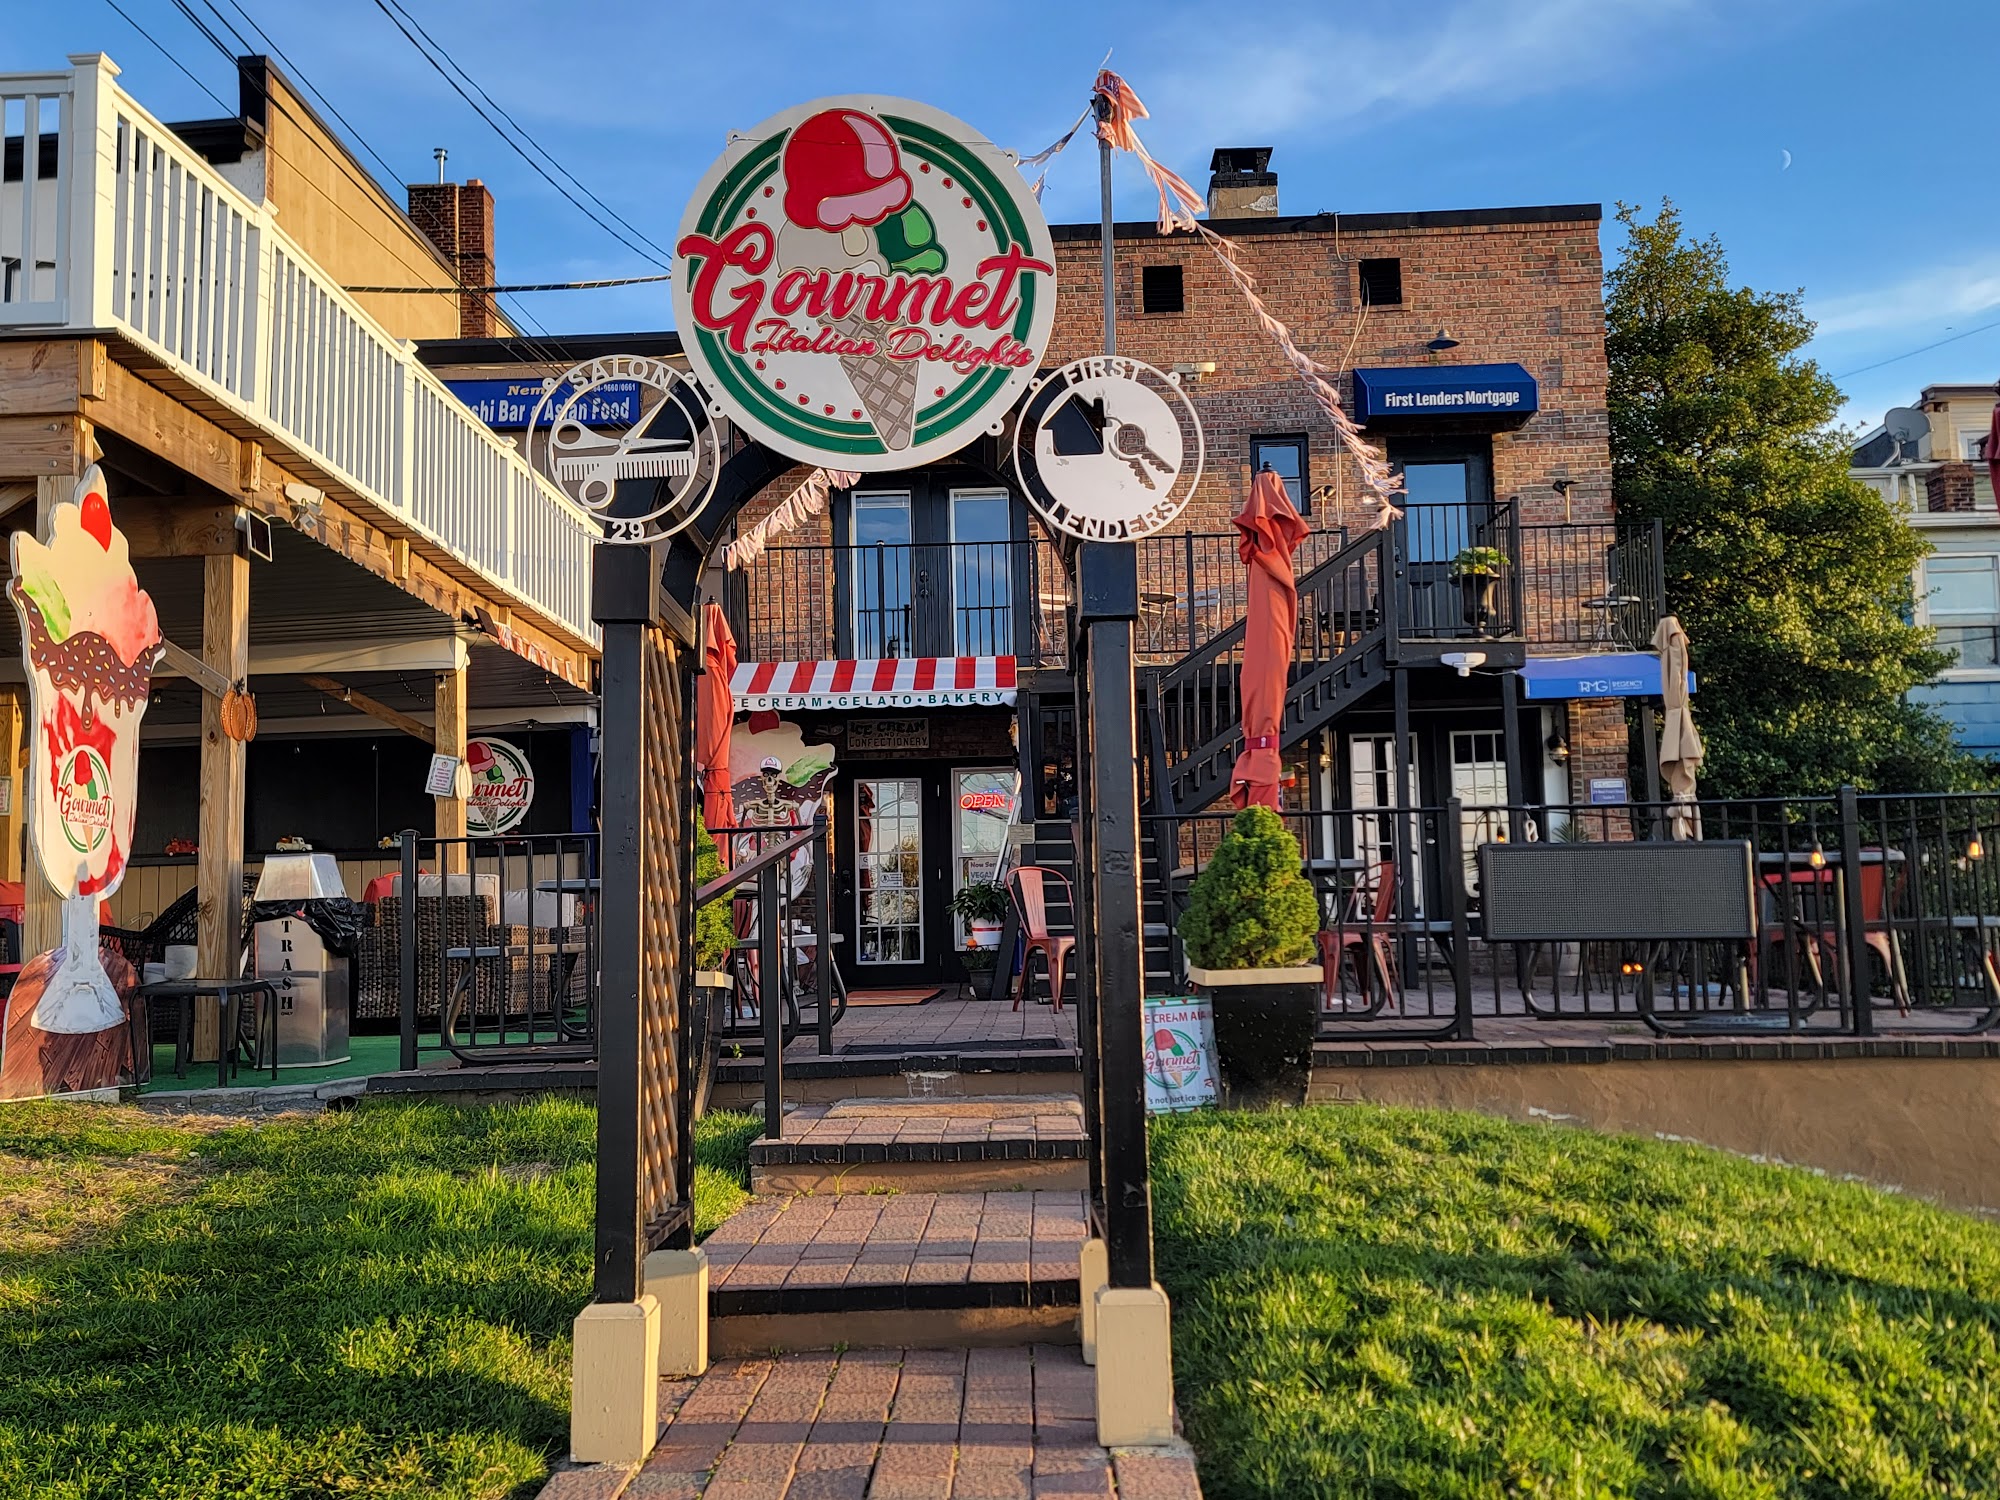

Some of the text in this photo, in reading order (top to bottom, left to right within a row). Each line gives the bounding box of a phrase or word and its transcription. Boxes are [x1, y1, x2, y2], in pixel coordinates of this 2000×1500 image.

[676, 221, 1054, 353] Gourmet
[751, 319, 1035, 375] Italian Delights
[567, 359, 673, 391] SALON
[1062, 358, 1147, 387] FIRST
[468, 399, 495, 422] shi
[498, 399, 526, 422] Bar
[592, 396, 630, 420] Food
[1385, 390, 1519, 408] First Lenders Mortgage
[611, 521, 645, 540] 29
[1047, 497, 1179, 540] LENDERS
[758, 697, 822, 708] CREAM
[838, 694, 912, 707] GELATO
[928, 691, 1003, 704] BAKERY
[472, 774, 532, 797] urmet
[58, 783, 112, 822] Gourmet
[960, 793, 1006, 809] OPEN
[281, 920, 293, 1010] TRASH
[1153, 1011, 1188, 1024] CREAM
[1155, 1096, 1168, 1104] not
[1170, 1095, 1185, 1105] just
[1186, 1094, 1196, 1102] ice
